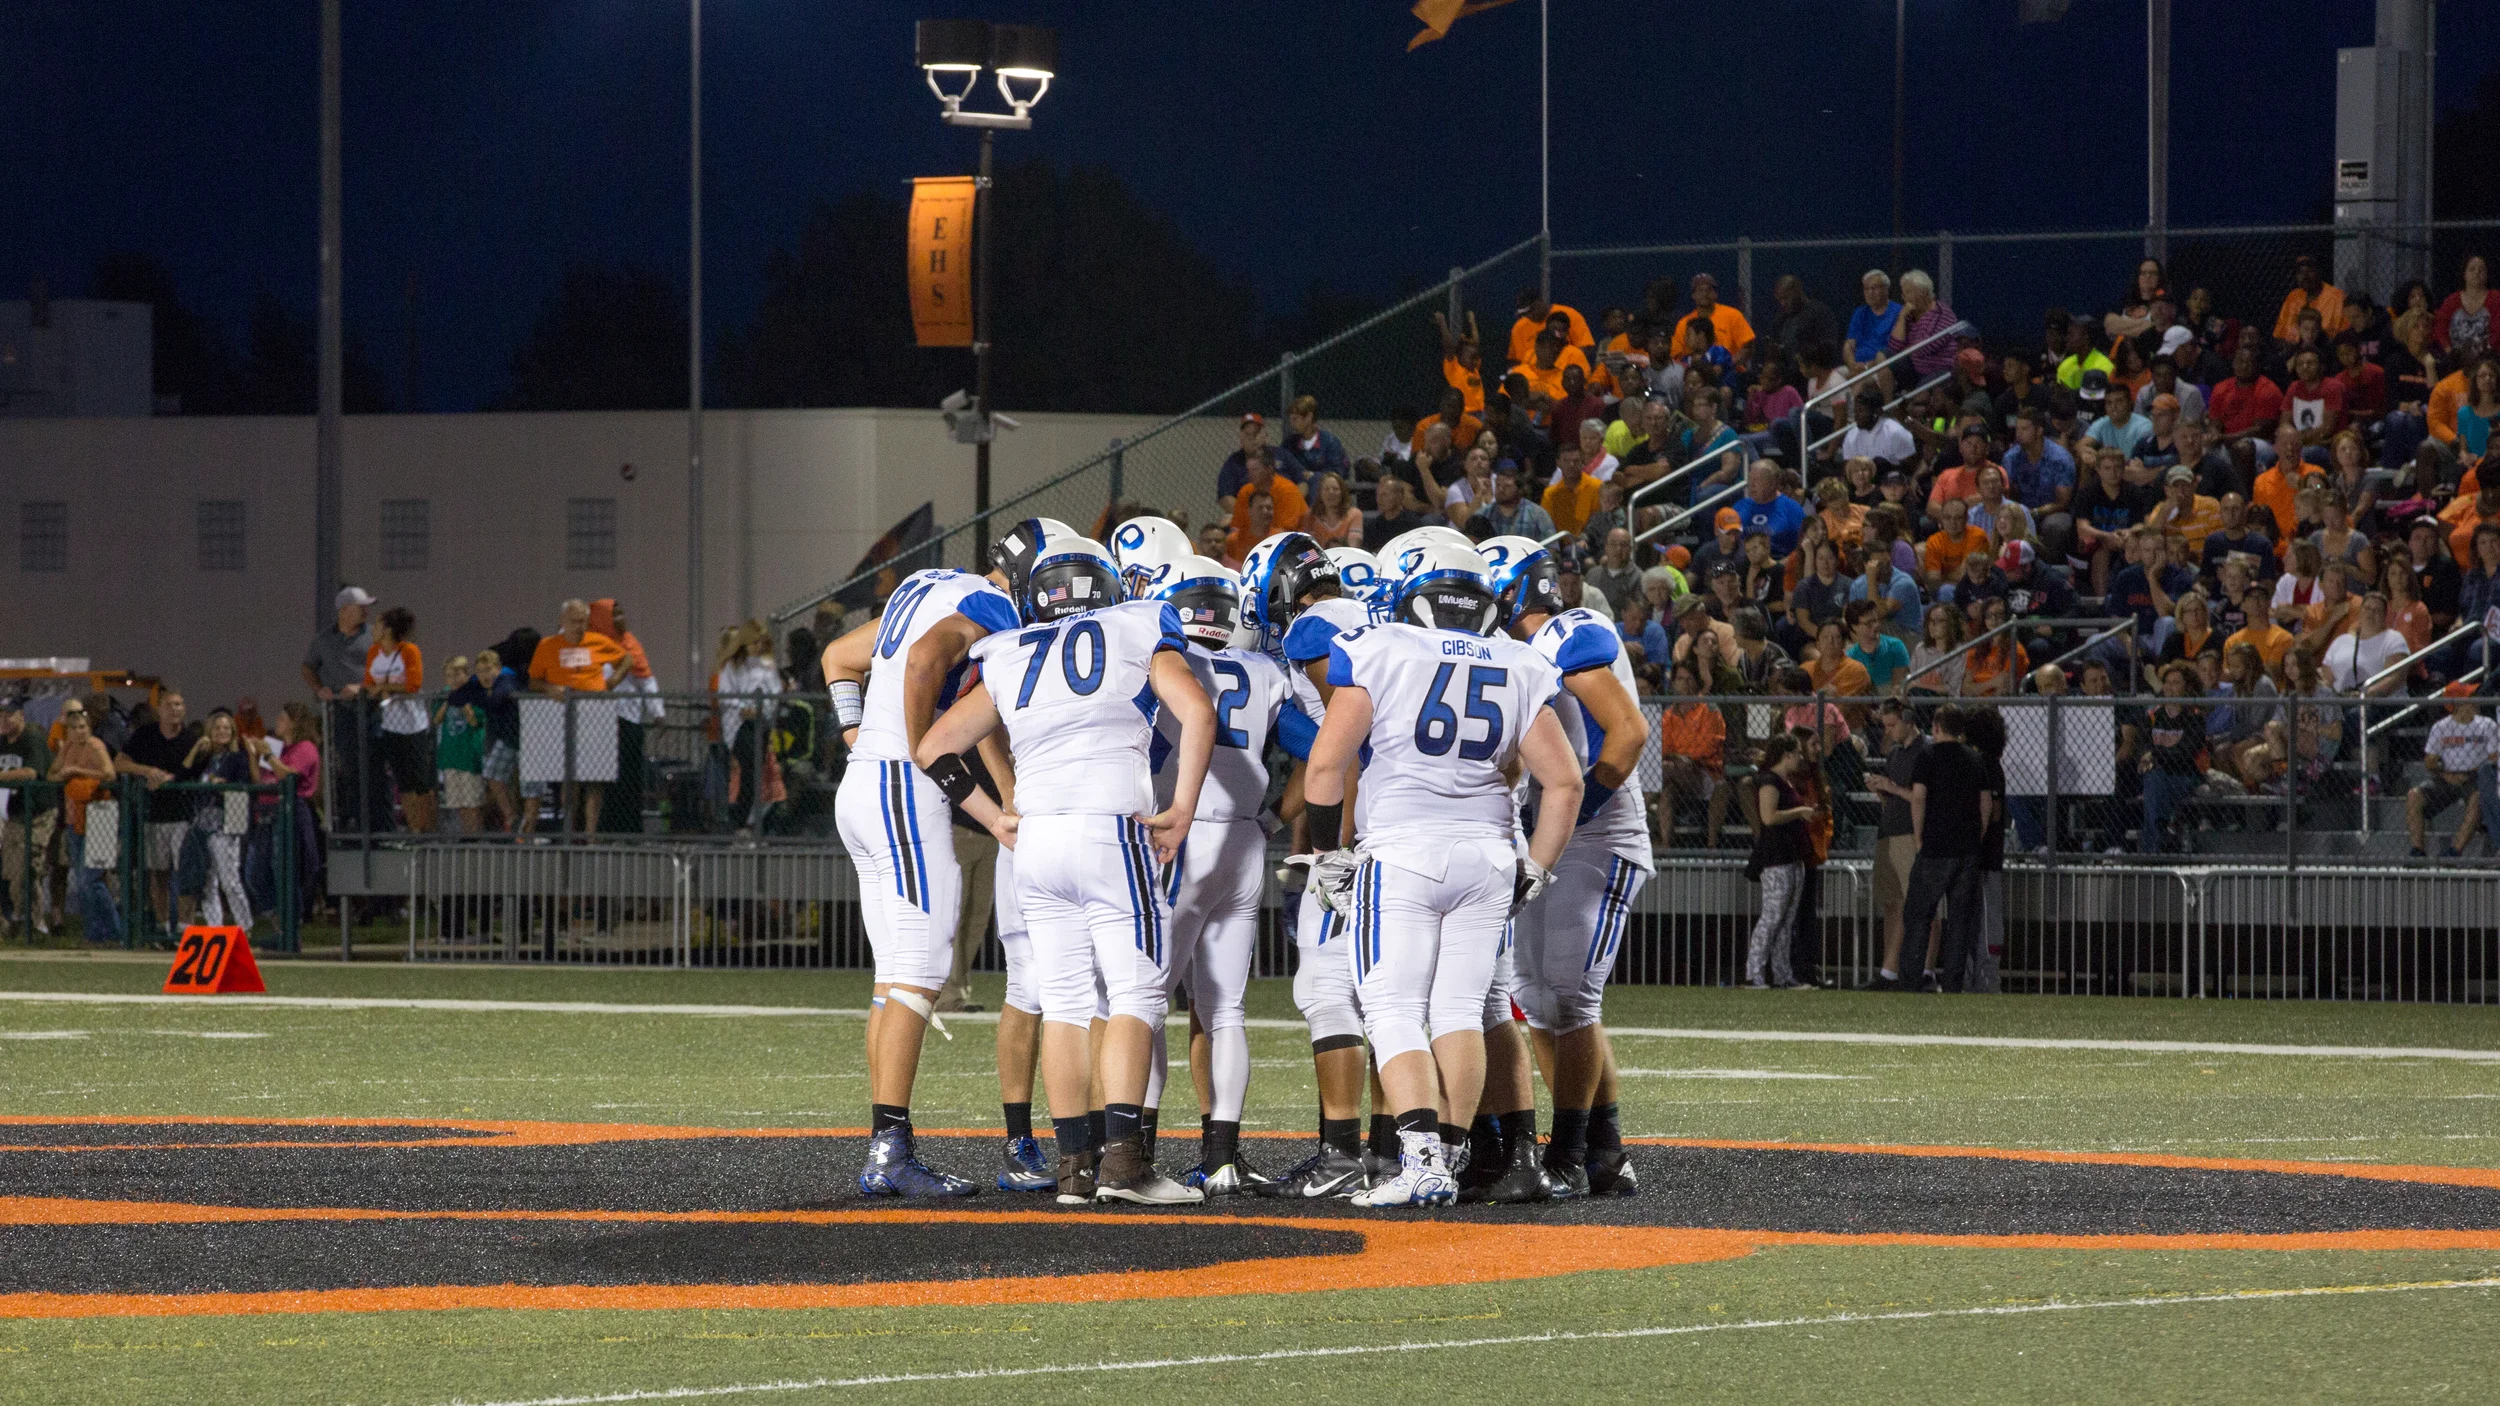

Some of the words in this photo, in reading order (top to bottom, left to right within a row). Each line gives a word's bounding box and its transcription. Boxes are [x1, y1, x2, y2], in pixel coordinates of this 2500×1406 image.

[931, 217, 948, 307] EHS
[1092, 590, 1102, 599] 70
[1341, 563, 1375, 587] Q
[1054, 605, 1087, 616] Riddell
[1544, 609, 1593, 640] 73
[1015, 620, 1107, 711] 70
[1442, 640, 1493, 661] GIBSON
[1210, 658, 1251, 750] 2
[1414, 661, 1508, 761] 65
[170, 935, 227, 985] 20
